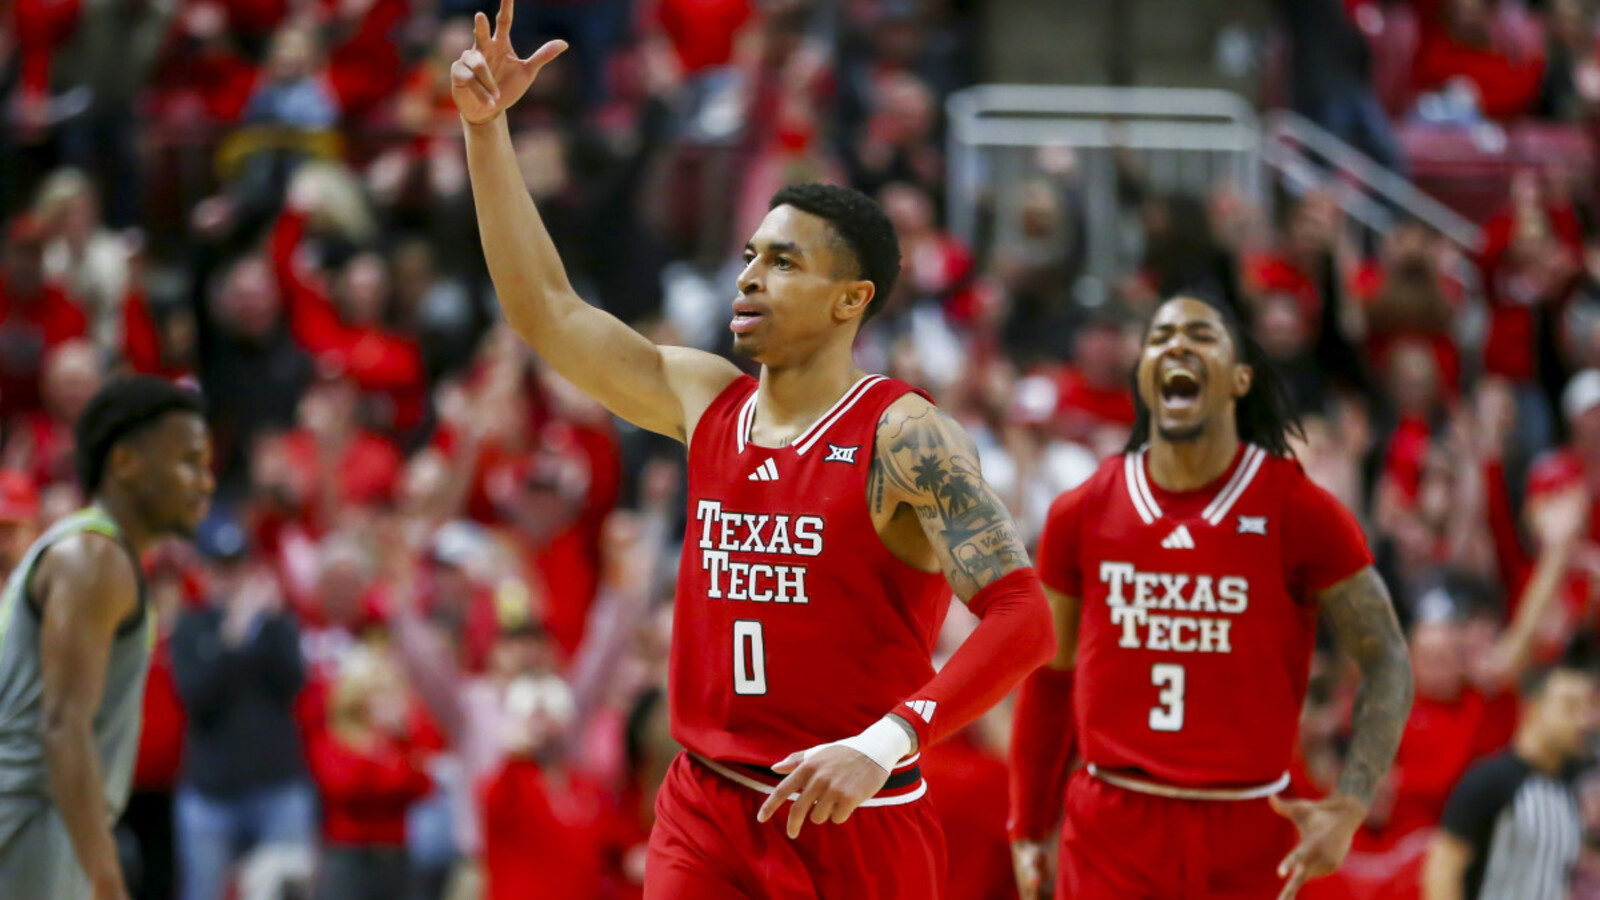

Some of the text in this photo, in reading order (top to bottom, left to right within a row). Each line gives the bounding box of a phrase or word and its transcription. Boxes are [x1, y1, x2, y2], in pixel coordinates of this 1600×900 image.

[824, 443, 860, 464] XII
[697, 499, 824, 556] TEXAS
[702, 549, 809, 604] TECH
[1100, 560, 1249, 614] TEXAS
[1110, 606, 1232, 653] TECH
[733, 619, 767, 696] 0
[1149, 663, 1185, 732] 3
